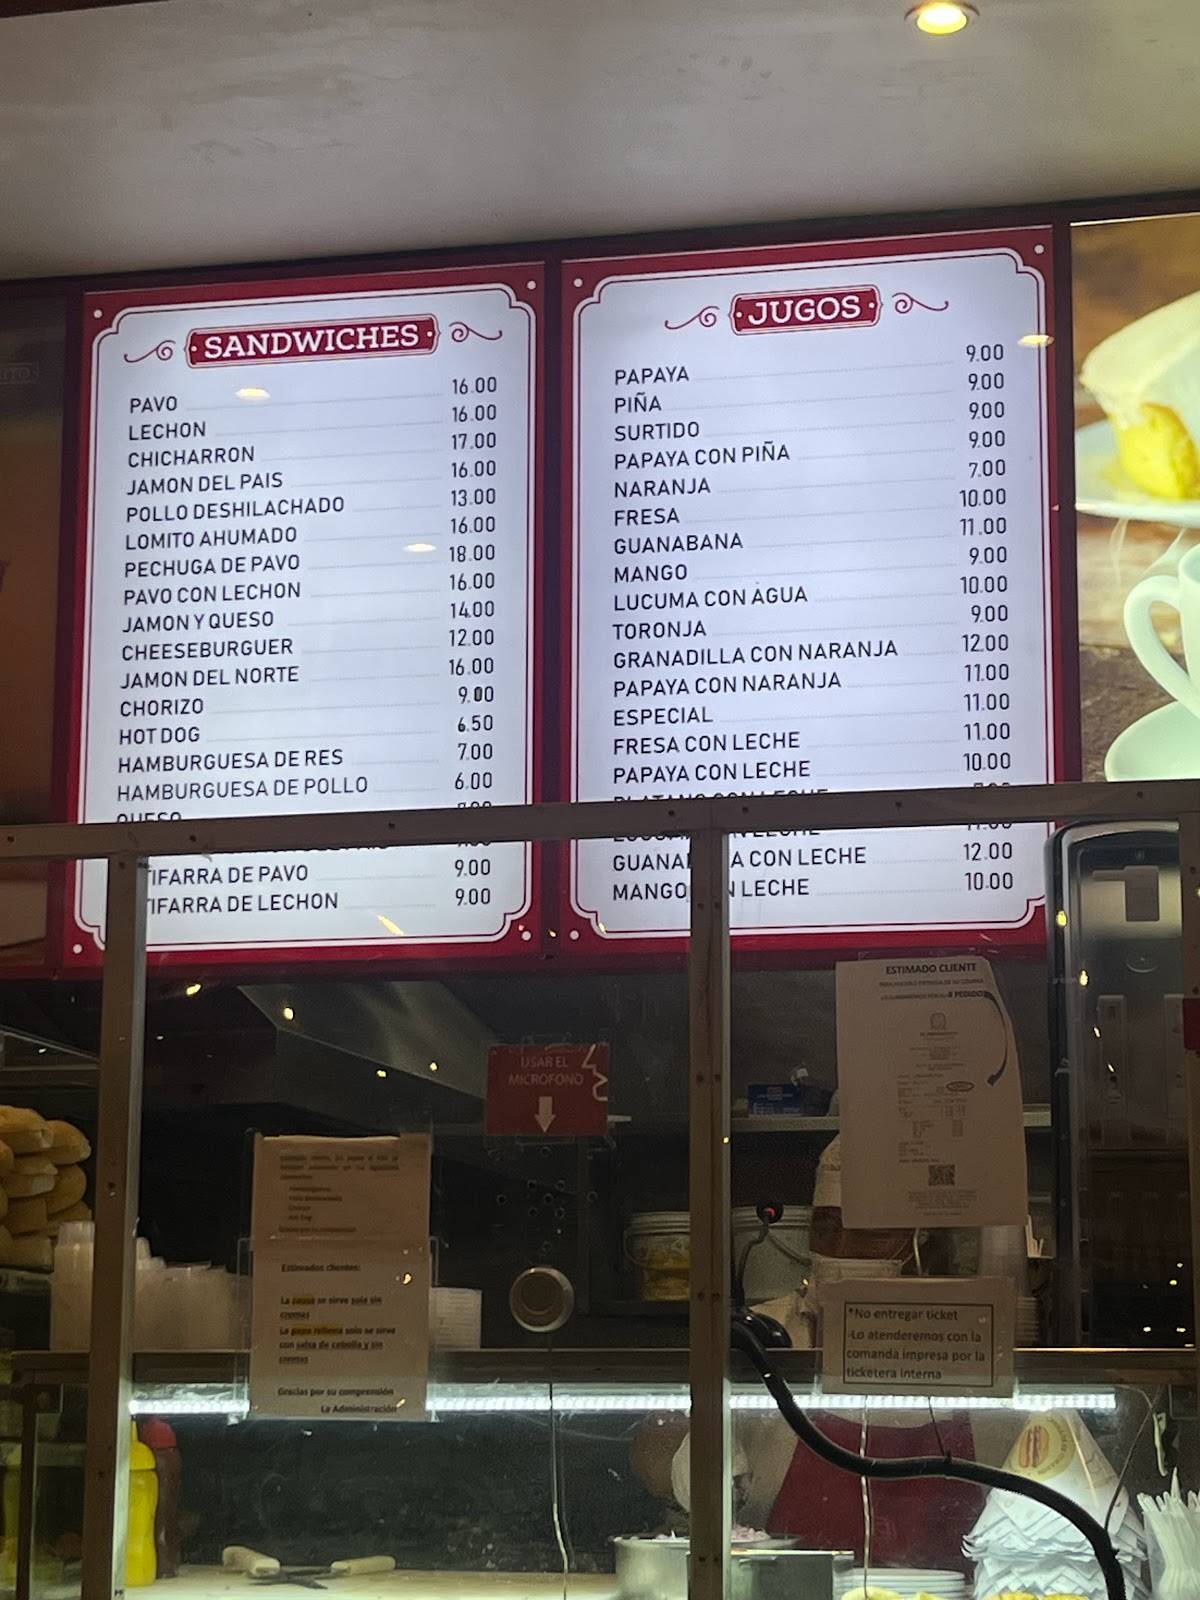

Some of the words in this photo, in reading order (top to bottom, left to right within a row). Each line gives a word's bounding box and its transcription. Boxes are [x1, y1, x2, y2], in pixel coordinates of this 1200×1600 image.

[748, 295, 862, 325] JUGOS
[204, 325, 419, 358] SANDWICHES
[615, 366, 689, 385] PAPAYA
[966, 344, 1003, 362] 9.00
[130, 396, 177, 414] PAVO
[453, 377, 497, 395] 16.00
[615, 392, 662, 414] PIÑA
[968, 372, 1004, 391] 9.00
[129, 421, 205, 440] LECHON
[452, 404, 496, 422] 16.00
[614, 421, 699, 441] SURTIDO
[969, 401, 1004, 420] 9.00
[128, 446, 254, 468] CHICHARRON
[452, 432, 496, 450] 17.00
[615, 450, 690, 470] PAPAYA
[695, 448, 735, 465] CON
[742, 441, 790, 462] PIÑA
[969, 430, 1005, 448] 9.00
[127, 477, 193, 495] JAMON
[199, 475, 235, 492] DEL
[240, 472, 282, 489] PAIS
[452, 460, 496, 478] 16.00
[615, 477, 711, 498] NARANJA
[969, 459, 1005, 478] 7.00
[127, 504, 188, 523] POLLO
[193, 496, 344, 519] DESHILACHADO
[451, 488, 495, 507] 13.00
[615, 508, 680, 526] FRESA
[960, 488, 1006, 507] 10.00
[126, 532, 194, 550] LOMITO
[199, 527, 296, 547] AHUMADO
[451, 516, 495, 534] 16.00
[614, 533, 743, 554] GUANABANA
[960, 517, 1006, 536] 11.00
[125, 558, 216, 578] PECHUGA
[221, 557, 246, 573] DE
[251, 554, 299, 572] PAVO
[449, 544, 495, 562] 18.00
[614, 564, 687, 583] MANGO
[970, 546, 1007, 565] 9.00
[124, 588, 172, 605] PAVO
[177, 586, 216, 603] CON
[223, 582, 300, 601] LECHON
[450, 572, 495, 591] 16.00
[614, 592, 699, 611] LUCUMA
[704, 589, 745, 607] CON
[751, 586, 809, 605] AGUA
[960, 575, 1007, 594] 10.00
[122, 615, 189, 633] JAMON
[194, 614, 205, 630] Y
[209, 611, 273, 629] QUESO
[451, 601, 494, 619] 14.00
[612, 620, 707, 640] TORONJA
[971, 605, 1008, 623] 9.00
[122, 638, 293, 661] CHEESEBURGUER
[449, 629, 494, 647] 12.00
[614, 647, 745, 669] GRANADILLA
[751, 645, 792, 663] CON
[799, 640, 898, 660] NARANJA
[962, 634, 1008, 652] 12.00
[120, 671, 187, 689] JAMON
[193, 669, 230, 686] DEL
[236, 666, 299, 684] NORTE
[449, 657, 494, 676] 16.00
[614, 678, 690, 698] PAPAYA
[695, 676, 736, 694] CON
[743, 672, 841, 692] NARANJA
[965, 664, 1009, 682] 11.00
[120, 698, 203, 717] CHORIZO
[458, 686, 494, 704] 9.00
[614, 706, 713, 726] ESPECIAL
[964, 693, 1009, 712] 11.00
[119, 728, 157, 745] HOT
[161, 726, 200, 743] DOG
[458, 715, 493, 732] 6.50
[614, 736, 680, 755] FRESA
[685, 734, 726, 752] CON
[733, 731, 800, 750] LECHE
[964, 722, 1010, 740] 11.00
[118, 752, 269, 773] HAMBURGUESA
[275, 751, 299, 767] DE
[305, 749, 343, 766] RES
[458, 743, 492, 760] 7.00
[614, 765, 690, 784] PAPAYA
[695, 763, 736, 781] CON
[743, 760, 810, 779] LECHE
[963, 752, 1010, 771] 10.00
[118, 780, 268, 801] HAMBURGUESA
[274, 779, 299, 796] DE
[304, 777, 367, 795] POLLO
[455, 772, 492, 790] 6.00
[750, 849, 791, 867] CON
[798, 847, 866, 865] LECHE
[964, 842, 1012, 861] 12.00
[147, 867, 223, 885] IFARRA
[228, 866, 254, 883] DE
[259, 865, 308, 882] PAVO
[455, 859, 490, 877] 9.00
[613, 882, 687, 901] MANGO
[742, 878, 809, 897] LECHE
[965, 872, 1013, 890] 10.00
[147, 895, 223, 915] IFARRA
[228, 895, 253, 912] DE
[258, 892, 338, 911] LECHON
[456, 888, 490, 906] 9.00
[886, 963, 936, 975] ESTIMADO
[521, 1056, 552, 1067] USAR
[556, 1057, 568, 1067] EL
[508, 1074, 584, 1085] MICROFONO
[971, 1333, 981, 1342] la
[975, 1352, 985, 1362] la
